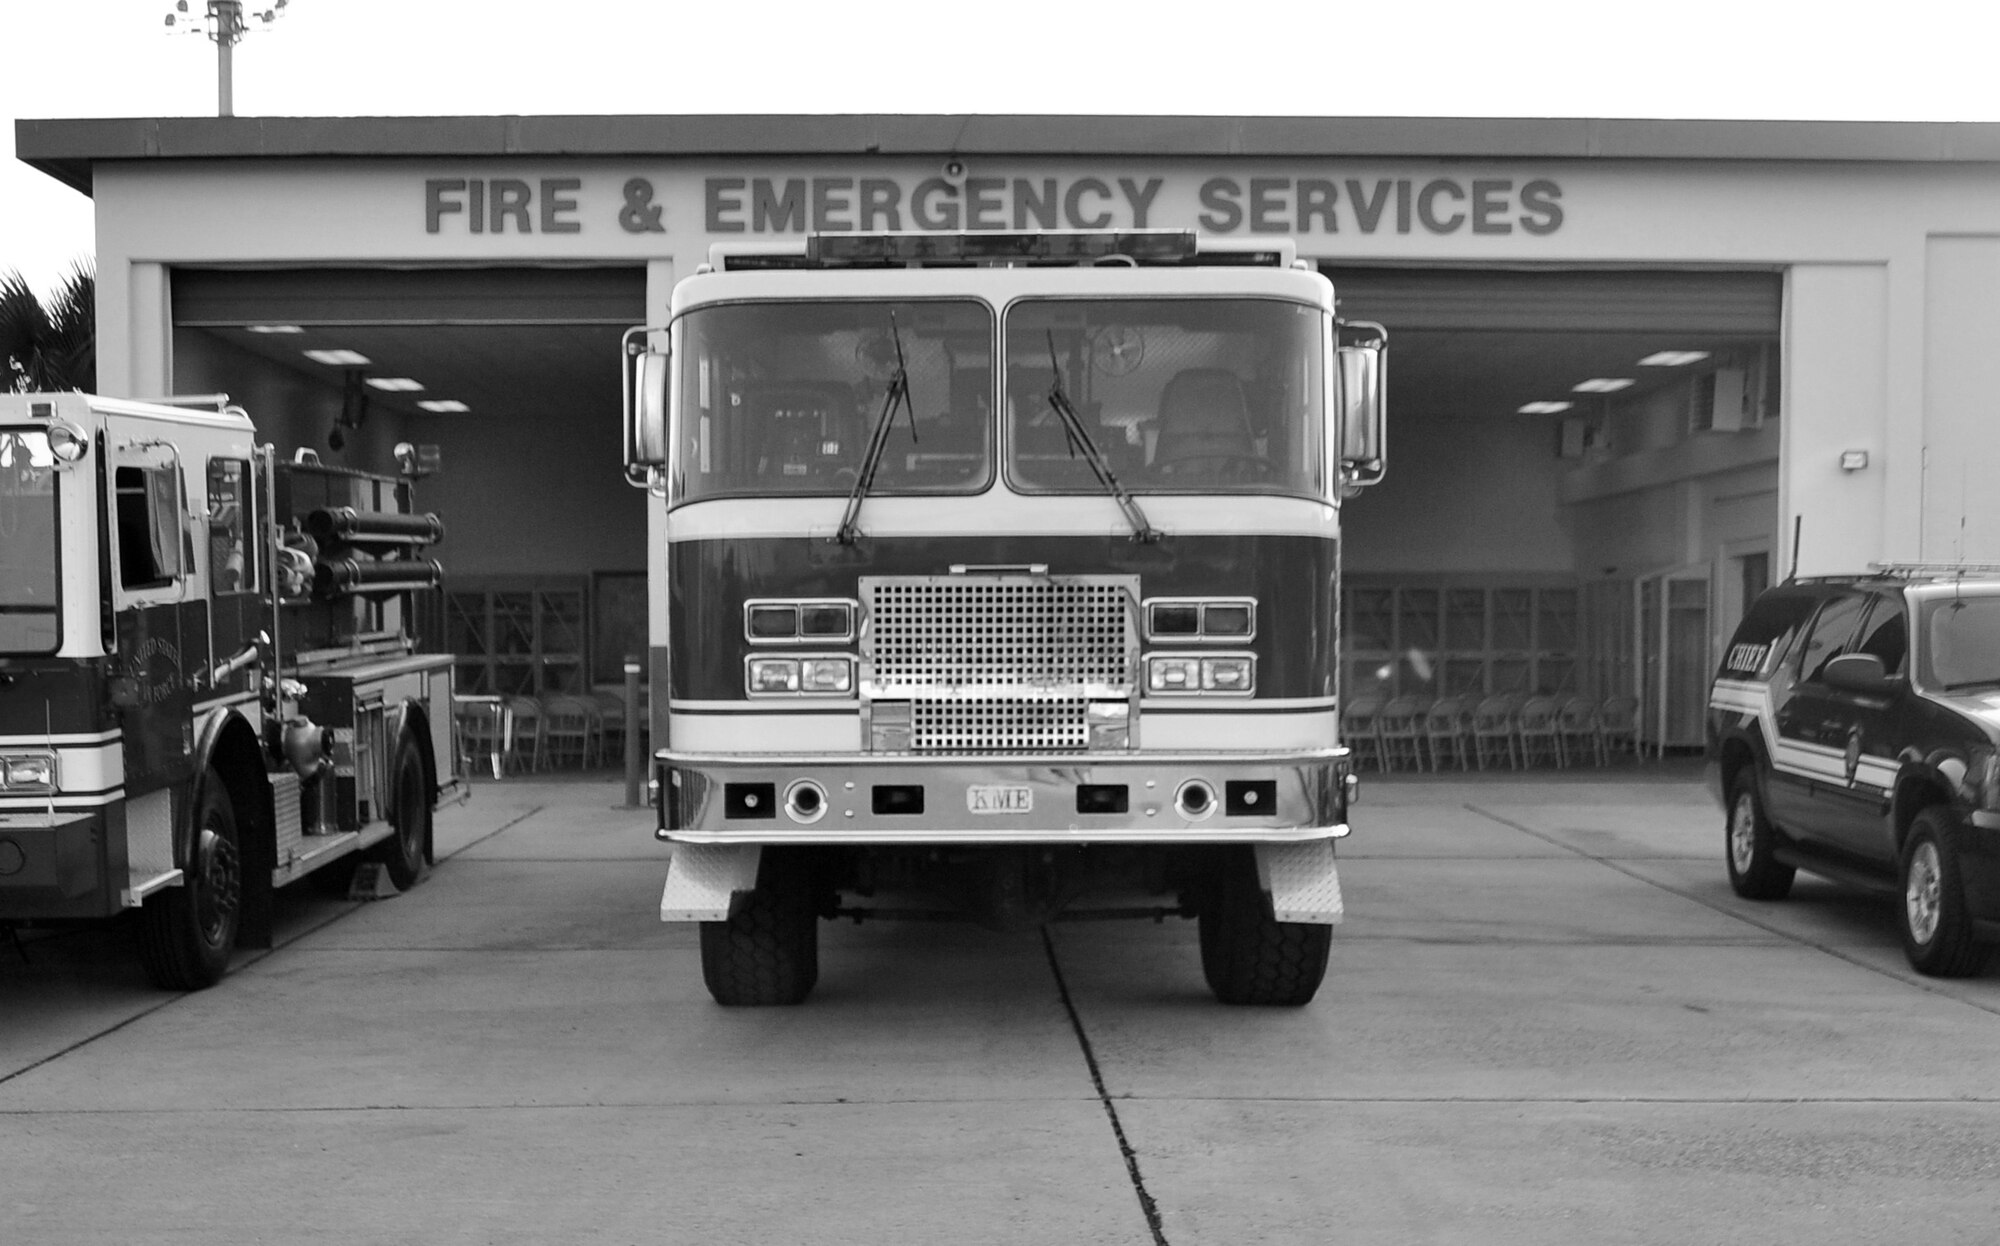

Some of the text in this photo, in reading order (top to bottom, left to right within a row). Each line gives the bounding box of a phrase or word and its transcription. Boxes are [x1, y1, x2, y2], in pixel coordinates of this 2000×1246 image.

[425, 177, 1564, 235] FIRE & EMERGENCY SERVICES
[1726, 642, 1768, 672] CHIEF
[972, 788, 1030, 810] KME
